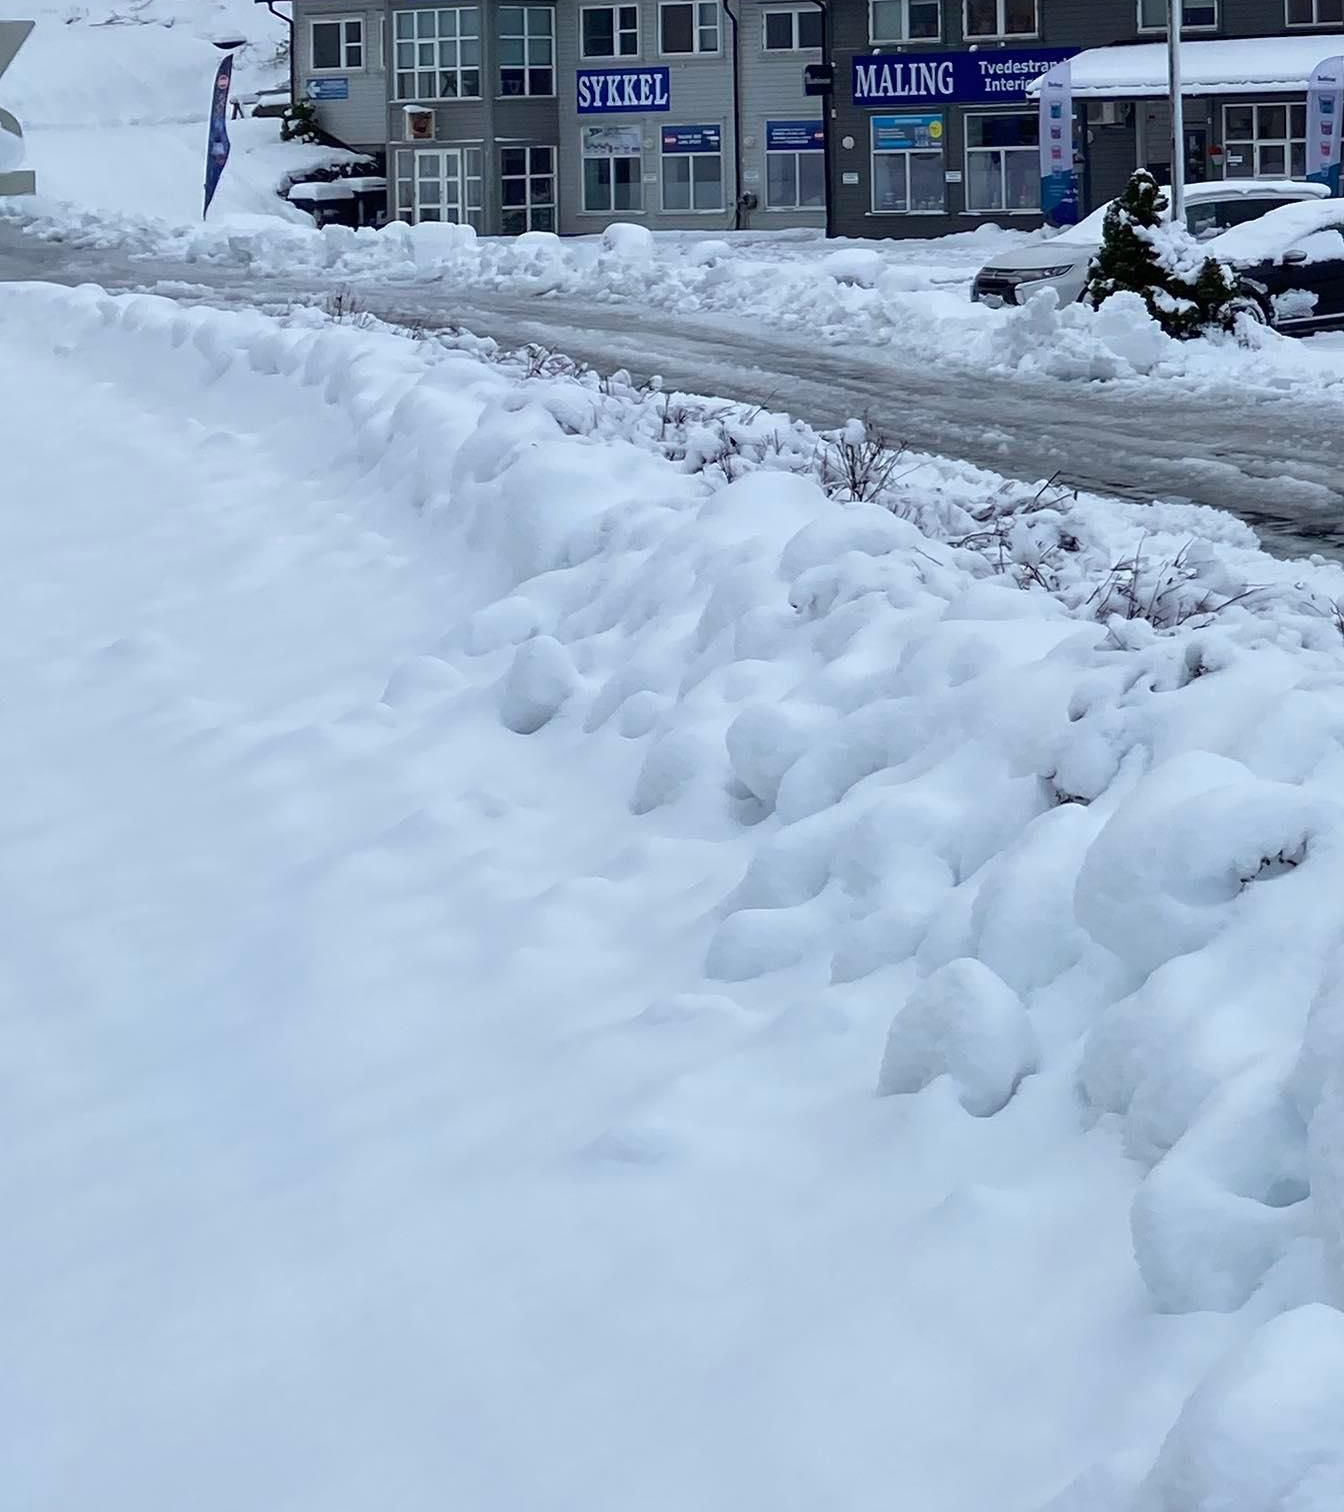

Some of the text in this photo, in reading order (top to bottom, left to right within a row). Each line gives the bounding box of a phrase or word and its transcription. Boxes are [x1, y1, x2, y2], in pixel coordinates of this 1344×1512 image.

[854, 61, 954, 99] MALING
[978, 58, 1066, 76] Tvedestran
[578, 73, 668, 108] SYKKEL
